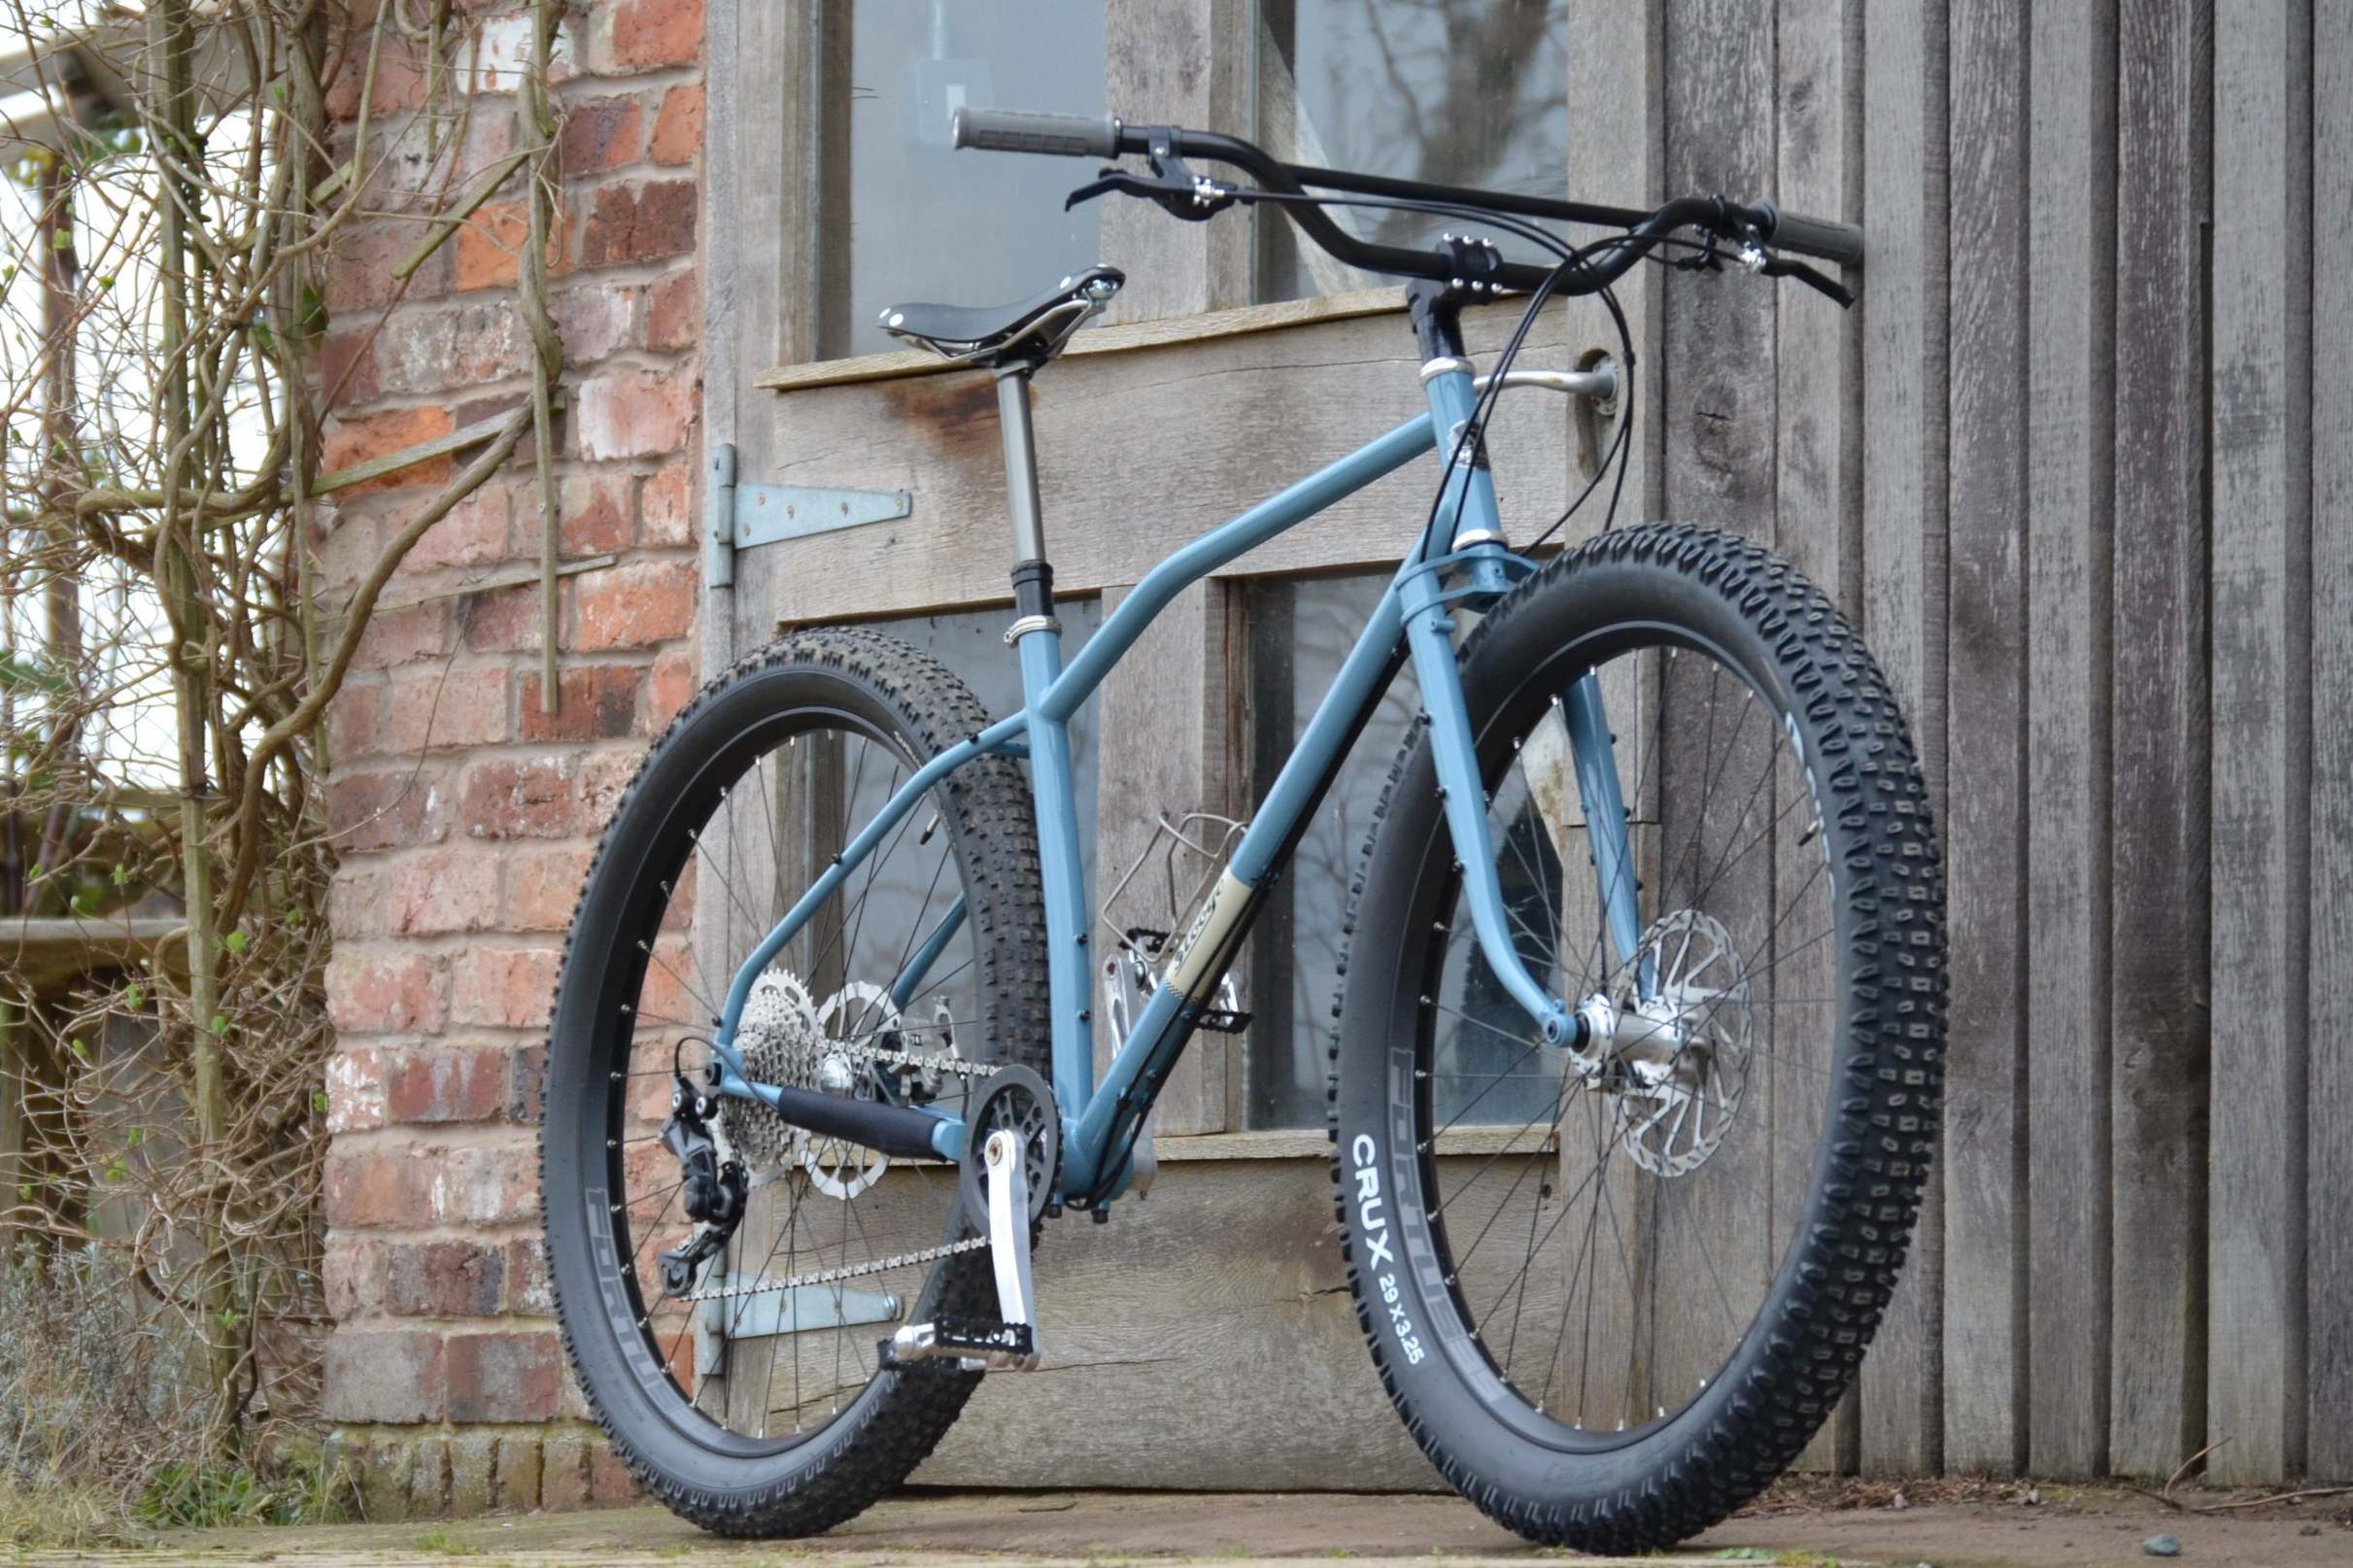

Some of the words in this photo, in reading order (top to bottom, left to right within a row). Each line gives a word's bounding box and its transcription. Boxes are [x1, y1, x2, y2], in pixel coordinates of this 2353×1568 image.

[586, 1188, 688, 1410] FORTUS
[1352, 1134, 1393, 1271] CRUX
[1389, 1048, 1466, 1343] FORTUS
